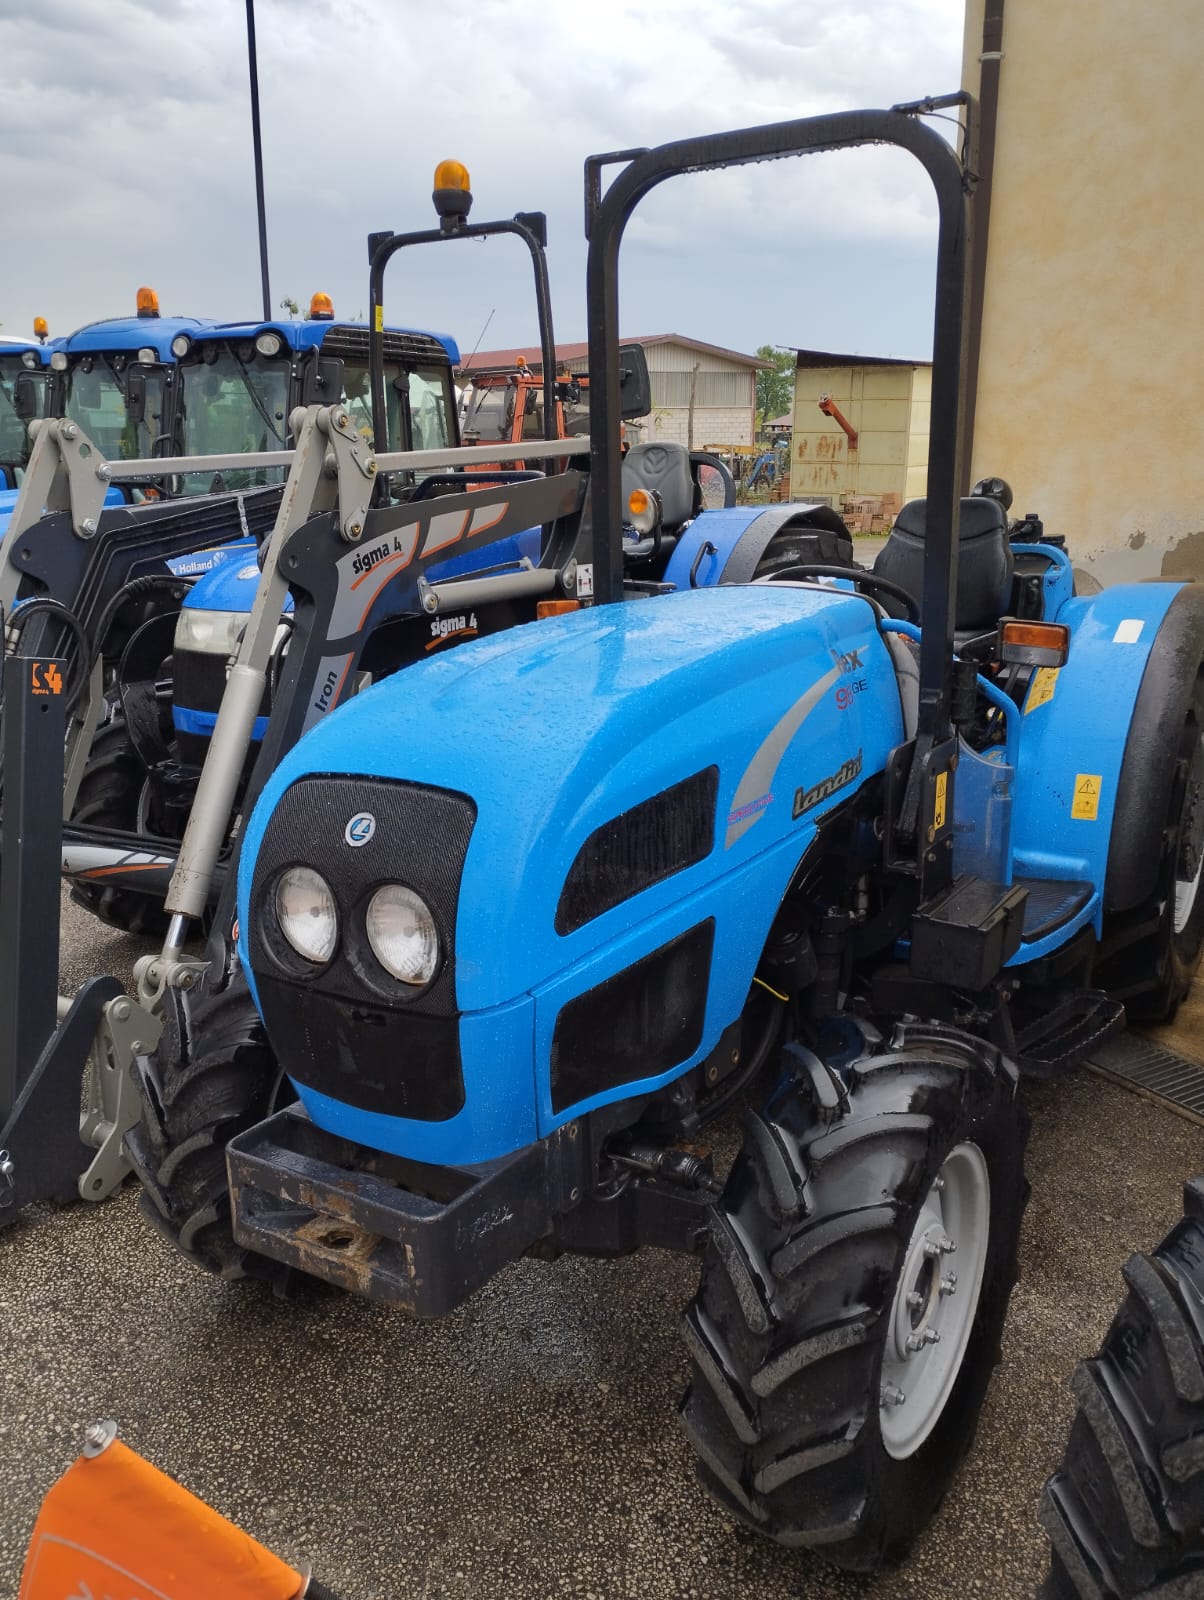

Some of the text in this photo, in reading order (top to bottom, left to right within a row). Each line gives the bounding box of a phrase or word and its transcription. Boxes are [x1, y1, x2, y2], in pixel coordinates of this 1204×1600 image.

[179, 559, 213, 574] Holland
[352, 536, 402, 574] sigma 4
[430, 612, 478, 637] sigma 4
[314, 671, 338, 713] Iron
